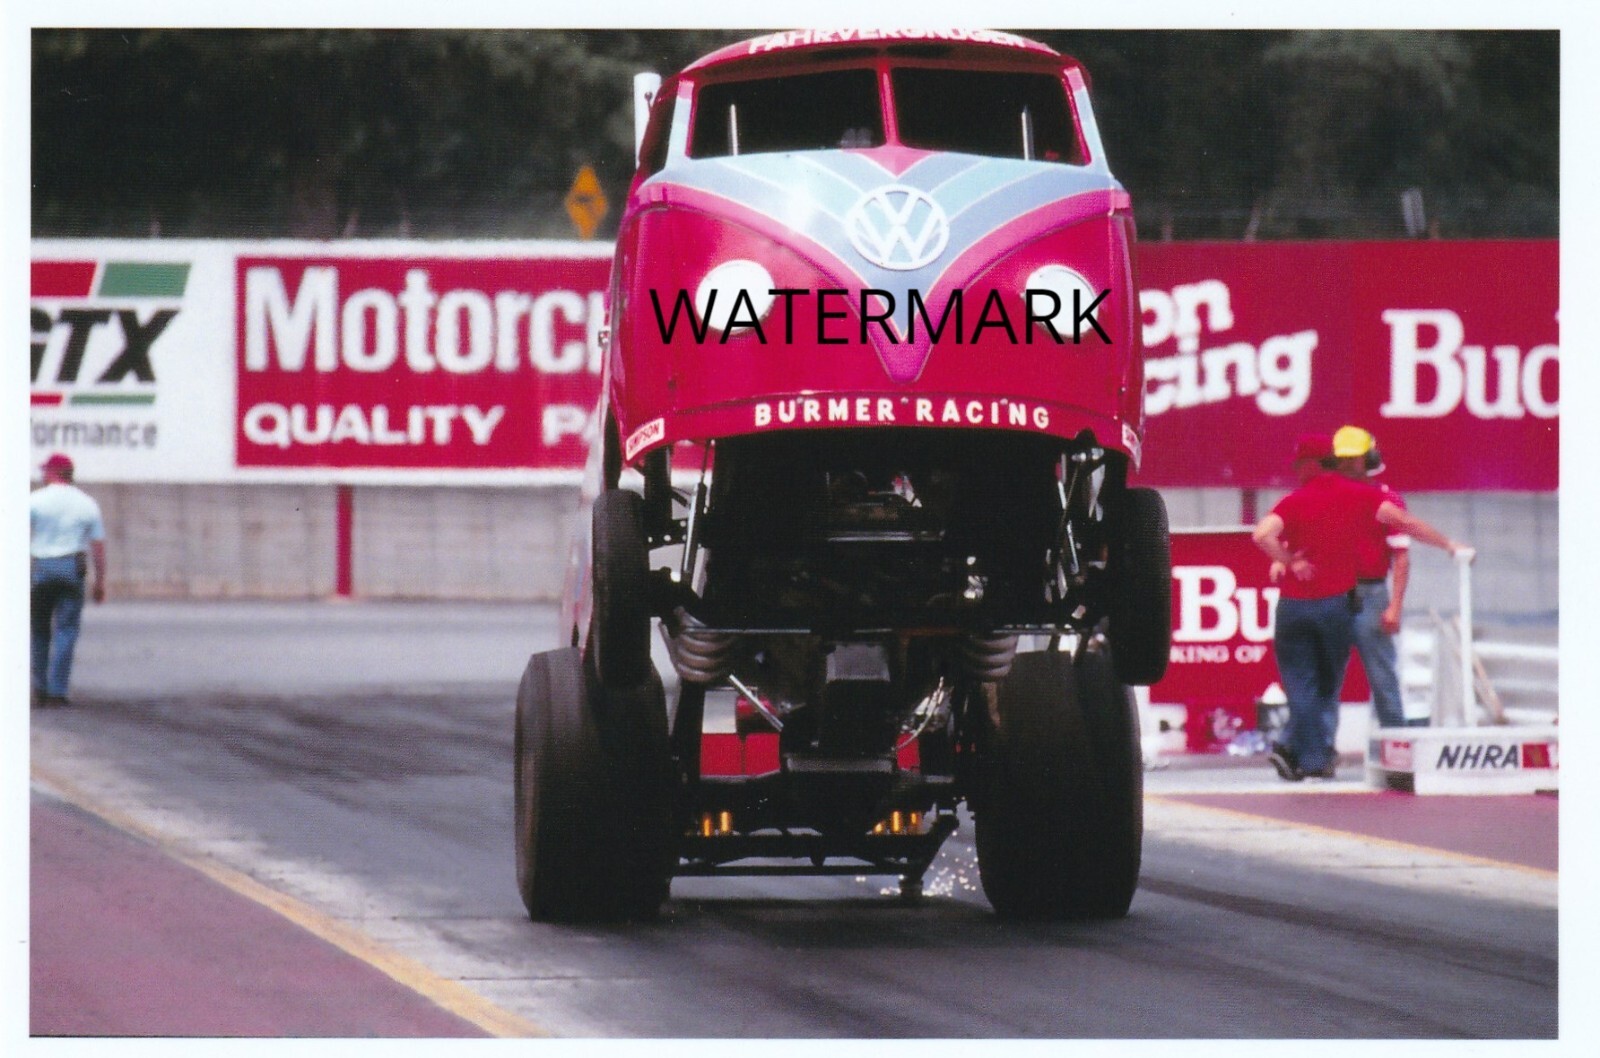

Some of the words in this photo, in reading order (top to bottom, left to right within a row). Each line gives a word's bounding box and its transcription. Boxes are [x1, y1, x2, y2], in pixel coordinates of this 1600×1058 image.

[243, 402, 505, 449] QUALITY
[755, 398, 896, 427] BURMER
[916, 398, 1050, 430] RACING
[30, 418, 158, 448] ormance
[1169, 645, 1230, 664] KING
[1235, 645, 1268, 664] OF
[1436, 744, 1519, 770] NHRA
